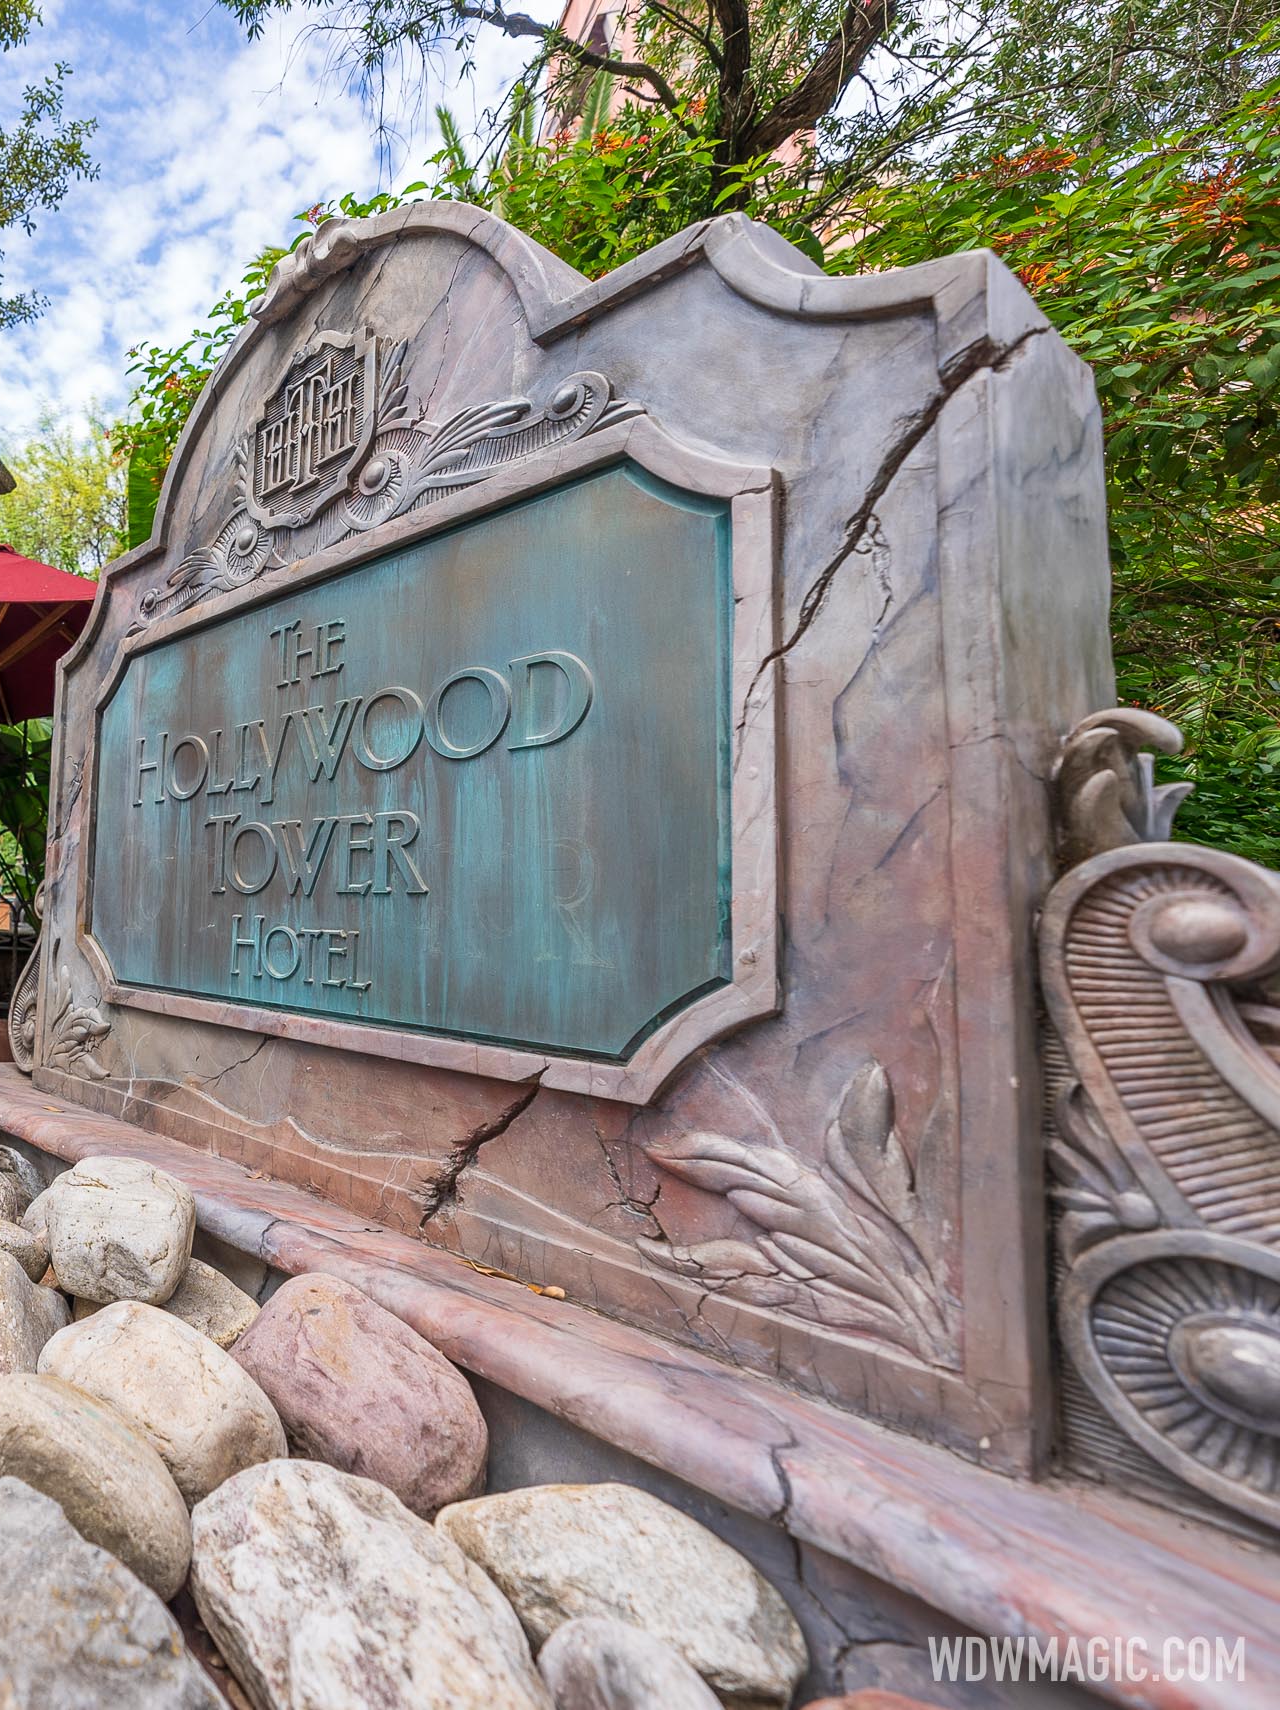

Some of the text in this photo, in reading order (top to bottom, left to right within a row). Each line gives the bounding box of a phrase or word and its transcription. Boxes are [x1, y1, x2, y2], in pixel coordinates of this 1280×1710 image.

[270, 617, 346, 688] THE
[133, 650, 595, 806] HOLLYWOOD
[205, 810, 429, 896] TOWER
[231, 914, 372, 991] HOTEL
